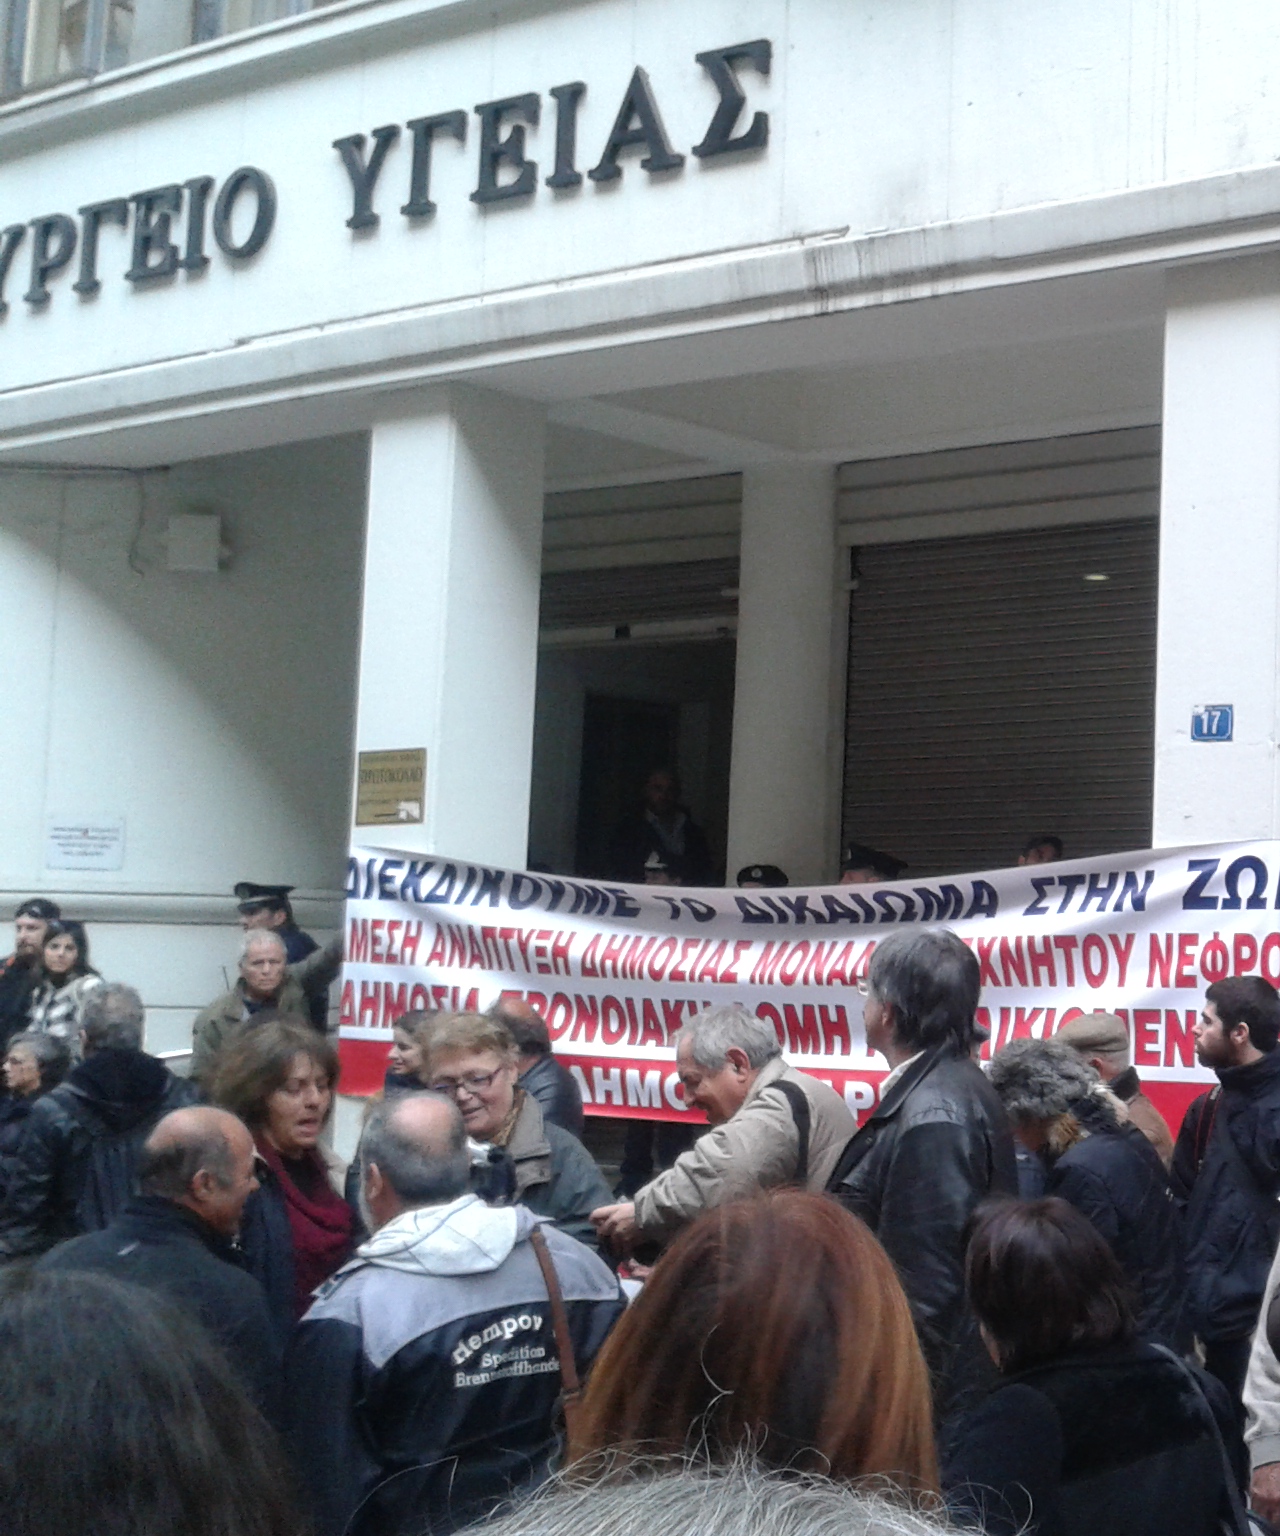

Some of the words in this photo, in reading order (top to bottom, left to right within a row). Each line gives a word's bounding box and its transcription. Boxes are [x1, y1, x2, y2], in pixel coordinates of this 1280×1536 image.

[333, 39, 774, 229] ΥΓΕΙΑΣ
[1201, 710, 1221, 734] 17
[346, 857, 641, 918] ΔΙΕΚΔΙΚΟΥΜΕ
[653, 895, 717, 922] ΤΟ
[734, 880, 998, 924] ΔΙΚΑΙΩΜΑ
[1022, 870, 1155, 916] ΣΤΗΝ
[344, 918, 423, 965] ΜΕΣΗ
[426, 922, 577, 976] ΑΝΑΠΤΥΞΗ
[581, 933, 753, 983] ΔΗΜΟΣΙΑΣ
[749, 939, 878, 986] ΜΟΝΑΔ
[501, 988, 711, 1048] ΡΟΝΟΙΑΚ
